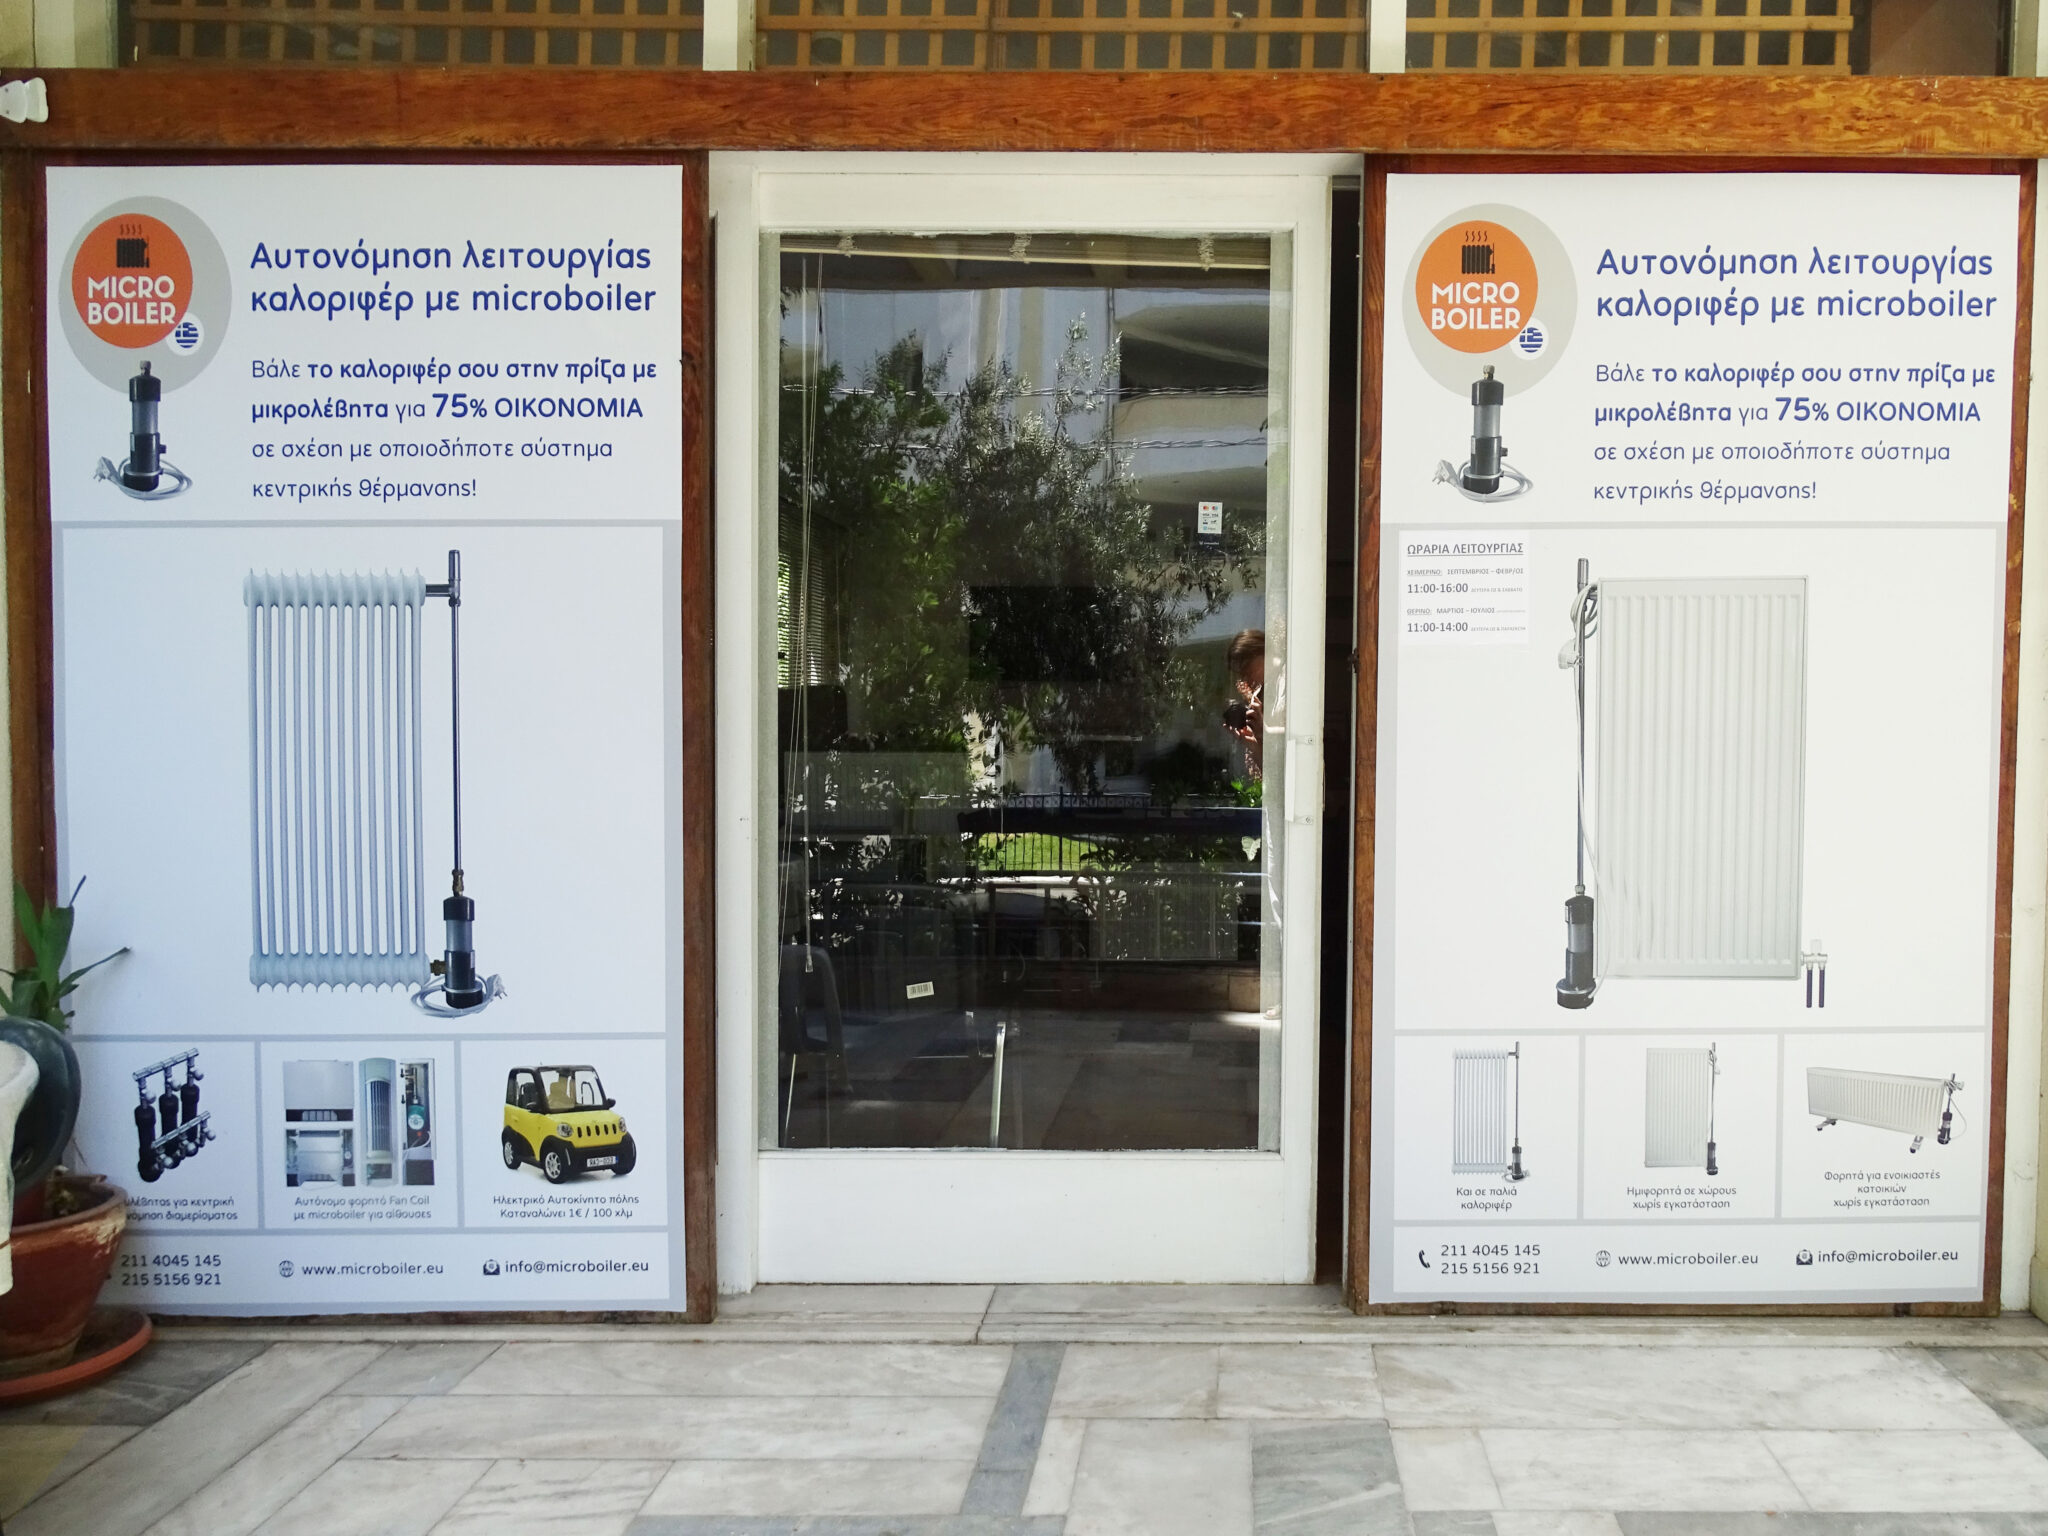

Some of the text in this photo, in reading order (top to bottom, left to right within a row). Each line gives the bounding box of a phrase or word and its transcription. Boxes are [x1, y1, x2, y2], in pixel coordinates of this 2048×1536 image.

[250, 238, 652, 280] Αυτονόμηση λειτουργίας
[1596, 244, 1993, 284] Αυτονόμηση λειτουργίας
[87, 275, 176, 300] MICRO
[1431, 281, 1520, 306] MICRO
[251, 280, 657, 320] καλοριφέρ με microboiler
[1596, 286, 1998, 326] καλοριφέρ με microboiler
[87, 301, 177, 326] BOILER
[1431, 306, 1521, 331] BOILER
[251, 357, 657, 384] Βάλε το καλοριφέρ σου στην πρίζα με
[1595, 361, 1996, 389] Βάλε το καλοριφέρ σου στην πρίζα με
[251, 393, 644, 425] μικρολέβητα για 75% ΟΙΚΟΝΟΜΙΑ
[1594, 396, 1982, 429] μικρολέβητα για 75% ΟΙΚΟΝΟΜΙΑ
[251, 435, 614, 464] σε σχέση με οποιοδήποτε σύστημα
[1593, 439, 1950, 467] σε σχέση με οποιοδήποτε σύστημα
[252, 475, 478, 503] κεντρικής θέρμανσης!
[1593, 478, 1817, 506] κεντρικής θέρμανσης!
[1407, 543, 1524, 555] ΩΡΑΡΙΑ ΛΕΙΤΟΥΡΓΙΑΣ
[1407, 583, 1469, 594] 11:00-16:00
[1407, 622, 1469, 633] 11:00-14:00
[1824, 1169, 1941, 1183] Φορητά για ενοικιαστές
[1456, 1186, 1517, 1196] Και σε παλιά
[1627, 1185, 1737, 1198] Ημιφορητά σε χώρους
[1857, 1183, 1906, 1194] κατοικιών
[173, 1198, 188, 1209] για
[190, 1196, 234, 1209] κεντρική
[295, 1195, 430, 1208] Αυτόνομο φορητό Fan Coil
[493, 1194, 640, 1207] Ηλεκτρικό Αυτοκίνητο πόλης
[1460, 1199, 1513, 1212] καλοριφέρ
[1633, 1198, 1730, 1212] χωρίς εγκατάσταση
[1833, 1196, 1930, 1209] χωρίς εγκατάσταση
[126, 1210, 238, 1222] νόμηση διαμερίσματος
[293, 1209, 431, 1222] με microboiler για αίθουσες
[500, 1208, 566, 1218] Καταναλώνει
[569, 1208, 582, 1217] 1€
[593, 1208, 612, 1217] 100
[615, 1208, 633, 1219] χλμ
[1440, 1244, 1541, 1257] 211 4045 145
[1818, 1249, 1959, 1263] info@microboiler.eu
[121, 1254, 222, 1267] 211 4045 145
[1618, 1252, 1759, 1265] www.microboiler.eu
[302, 1261, 444, 1275] www.microboiler.eu
[505, 1259, 649, 1273] info@microboiler.eu
[1441, 1262, 1540, 1275] 215 5156 921
[122, 1273, 221, 1286] 215 5156 921
